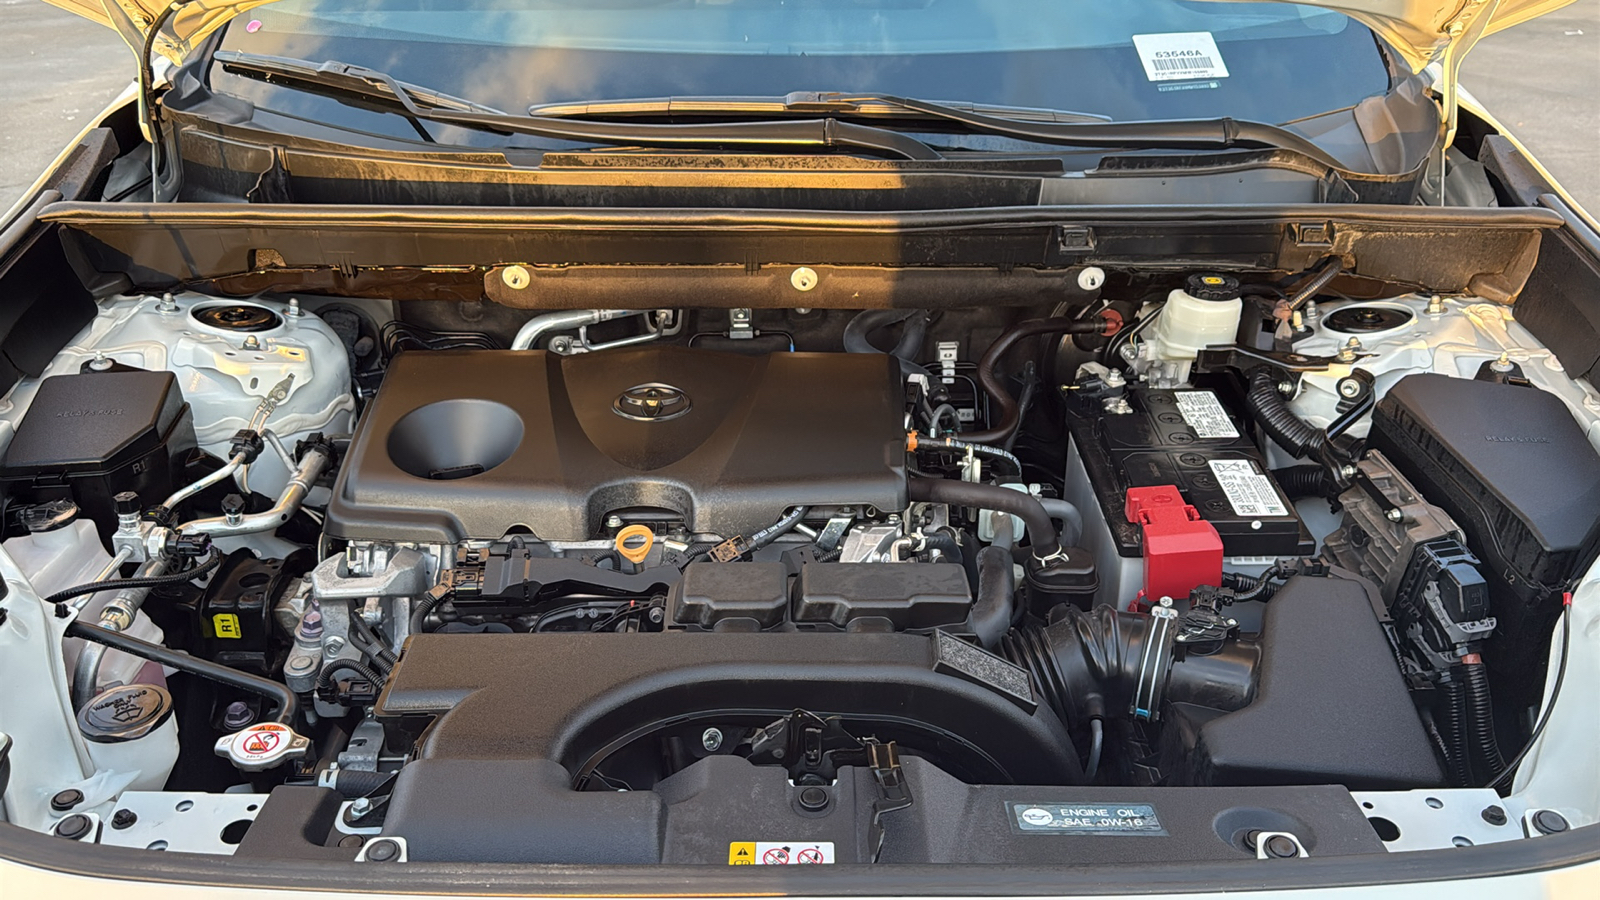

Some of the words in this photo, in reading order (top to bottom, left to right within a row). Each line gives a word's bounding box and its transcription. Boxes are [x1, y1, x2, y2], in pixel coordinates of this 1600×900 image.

[132, 460, 146, 474] R1
[220, 618, 233, 633] R1
[1060, 808, 1109, 817] ENGINE
[1117, 809, 1141, 817] OIL
[1064, 817, 1091, 827] SAE
[1101, 818, 1144, 827] 0W-16
